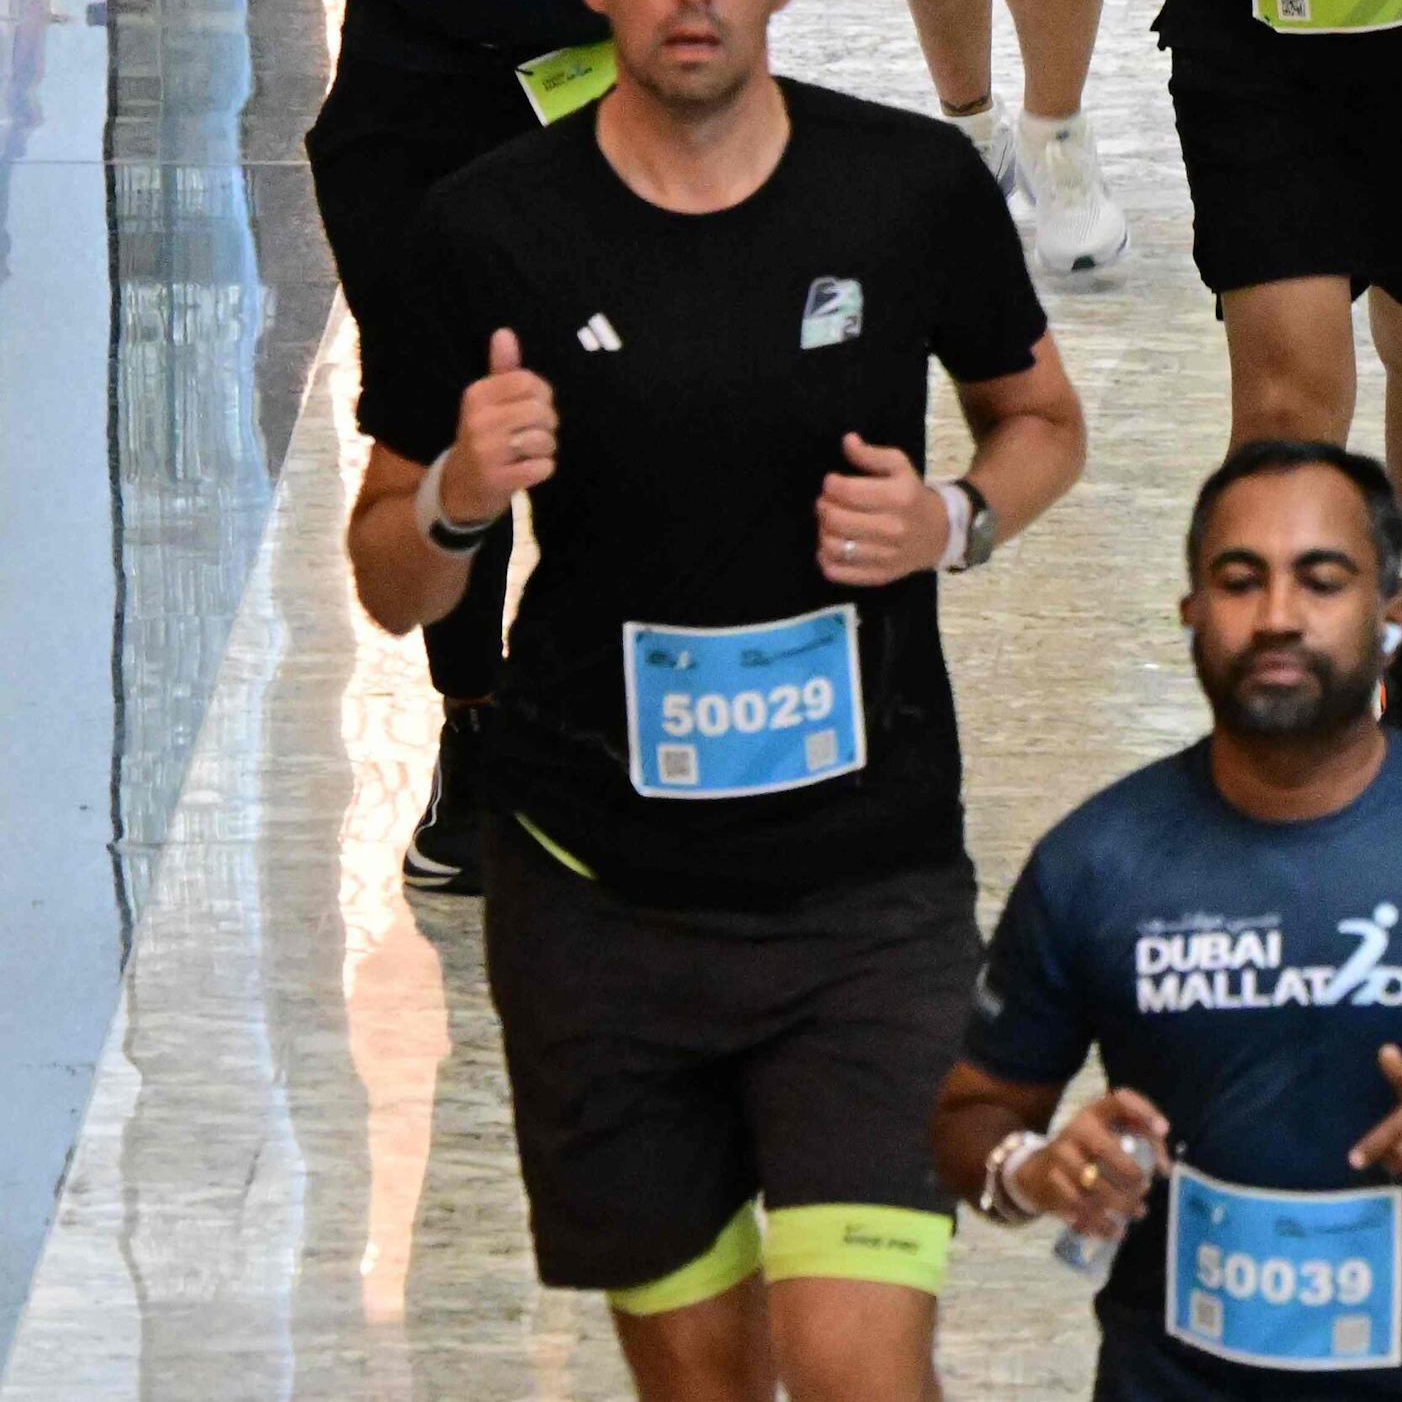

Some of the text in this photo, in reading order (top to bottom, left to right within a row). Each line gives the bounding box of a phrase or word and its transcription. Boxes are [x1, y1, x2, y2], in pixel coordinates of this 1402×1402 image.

[662, 677, 834, 737] 50029
[1136, 930, 1283, 975] DUBAI
[1197, 1245, 1373, 1306] 50039
